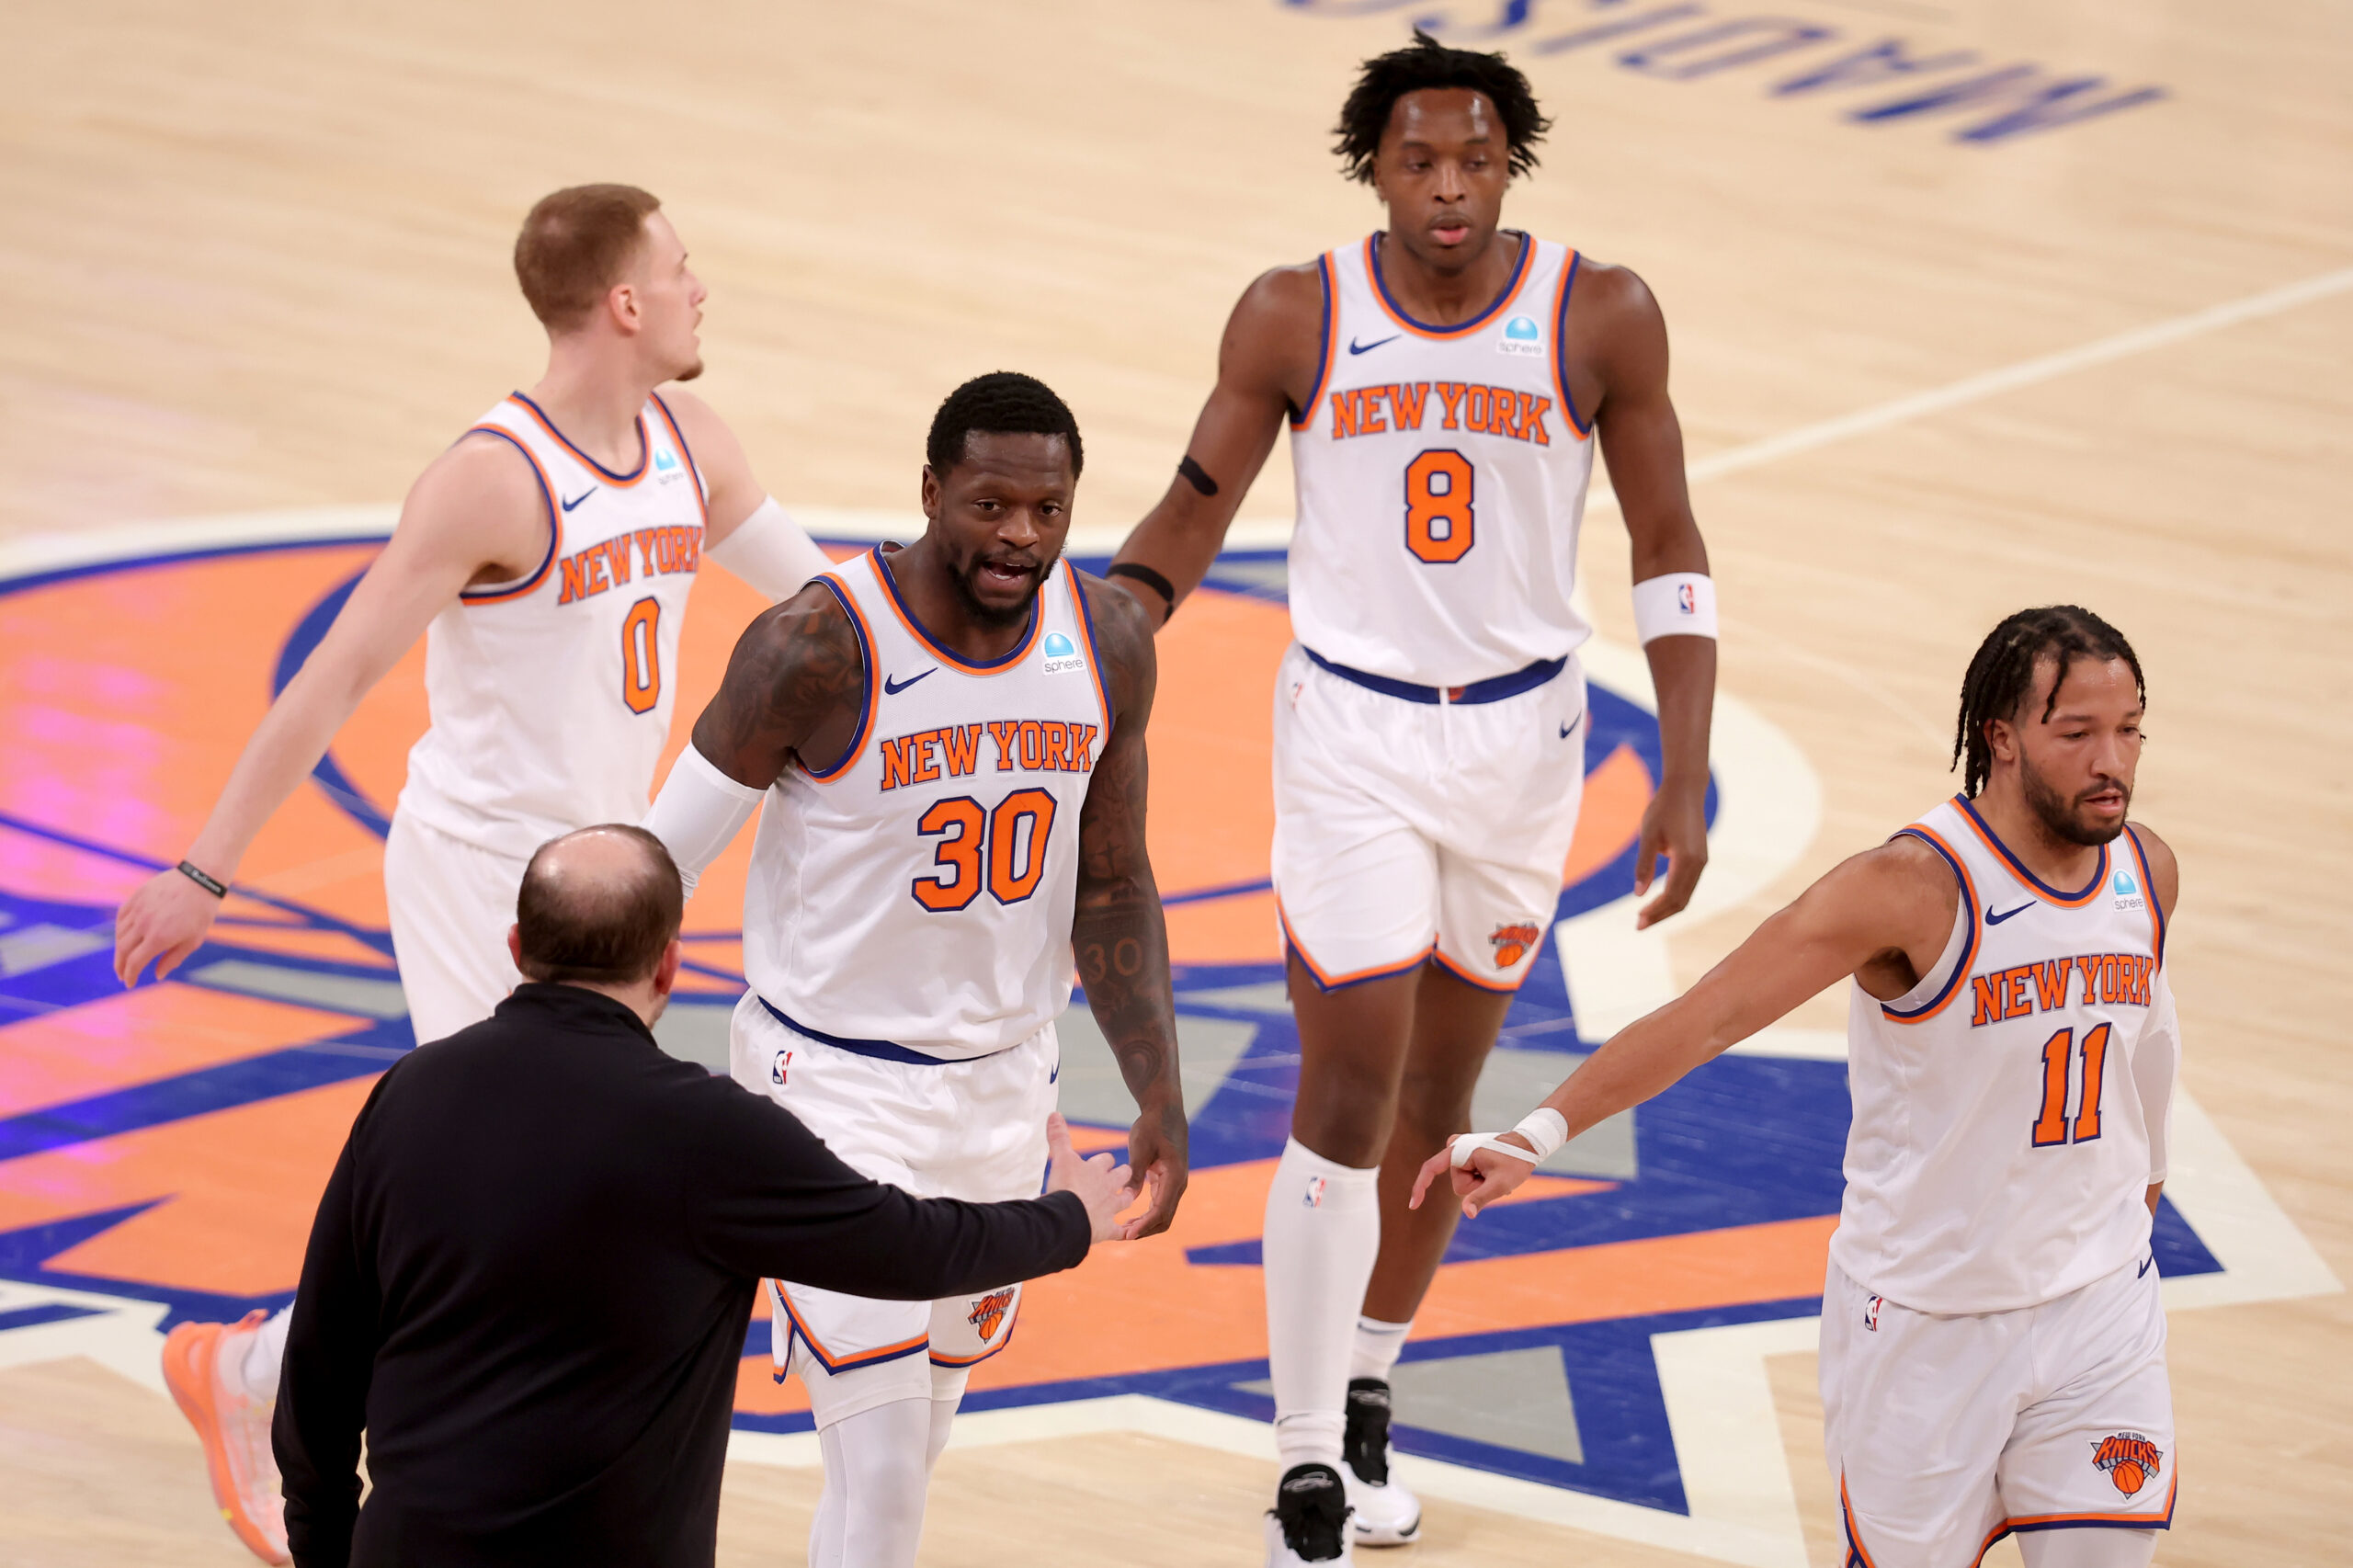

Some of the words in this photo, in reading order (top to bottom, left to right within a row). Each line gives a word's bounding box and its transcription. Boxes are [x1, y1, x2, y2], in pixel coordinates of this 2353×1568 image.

[1331, 382, 1430, 440] NEW
[1435, 381, 1552, 447] YORK
[1405, 449, 1475, 564] 8
[557, 533, 631, 607] NEW
[634, 525, 702, 577] YORK
[621, 596, 661, 715] 0
[1044, 659, 1084, 674] sphere
[880, 722, 983, 792] NEW
[987, 720, 1097, 773] YORK
[911, 787, 1058, 913] 30
[2114, 898, 2144, 911] sphere
[1972, 958, 2072, 1028] NEW
[2076, 953, 2154, 1008] YORK
[2031, 1021, 2112, 1148] 11
[2092, 1435, 2160, 1472] KNICKS
